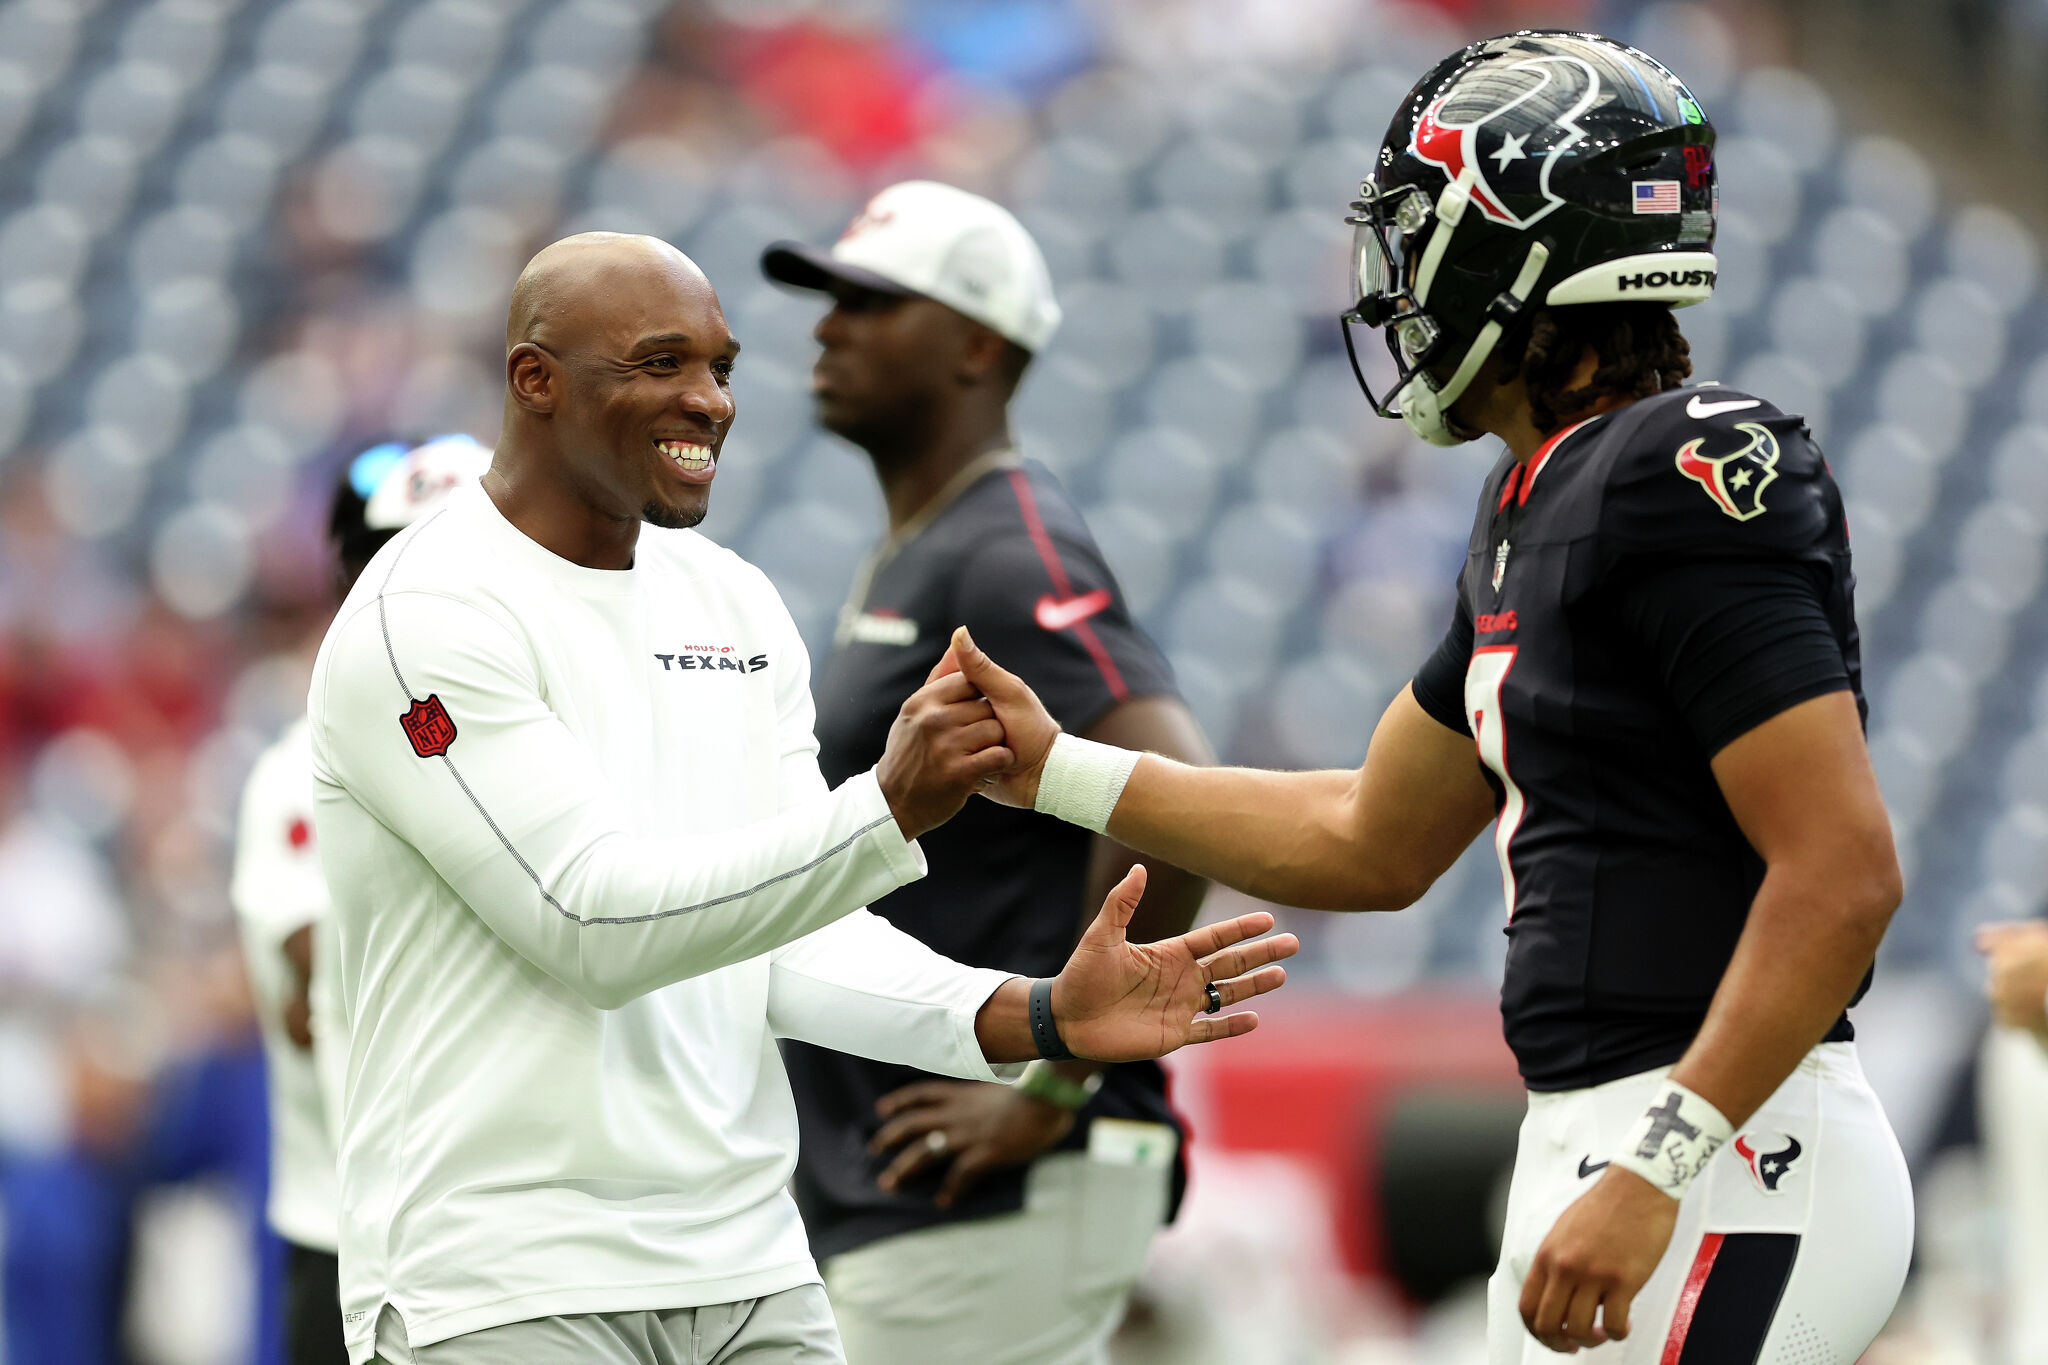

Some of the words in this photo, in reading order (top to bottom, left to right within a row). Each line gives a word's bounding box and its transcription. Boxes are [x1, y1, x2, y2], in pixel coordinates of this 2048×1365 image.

[1618, 269, 1718, 291] HOUST
[684, 644, 735, 654] HOUSO
[418, 721, 447, 746] NFL
